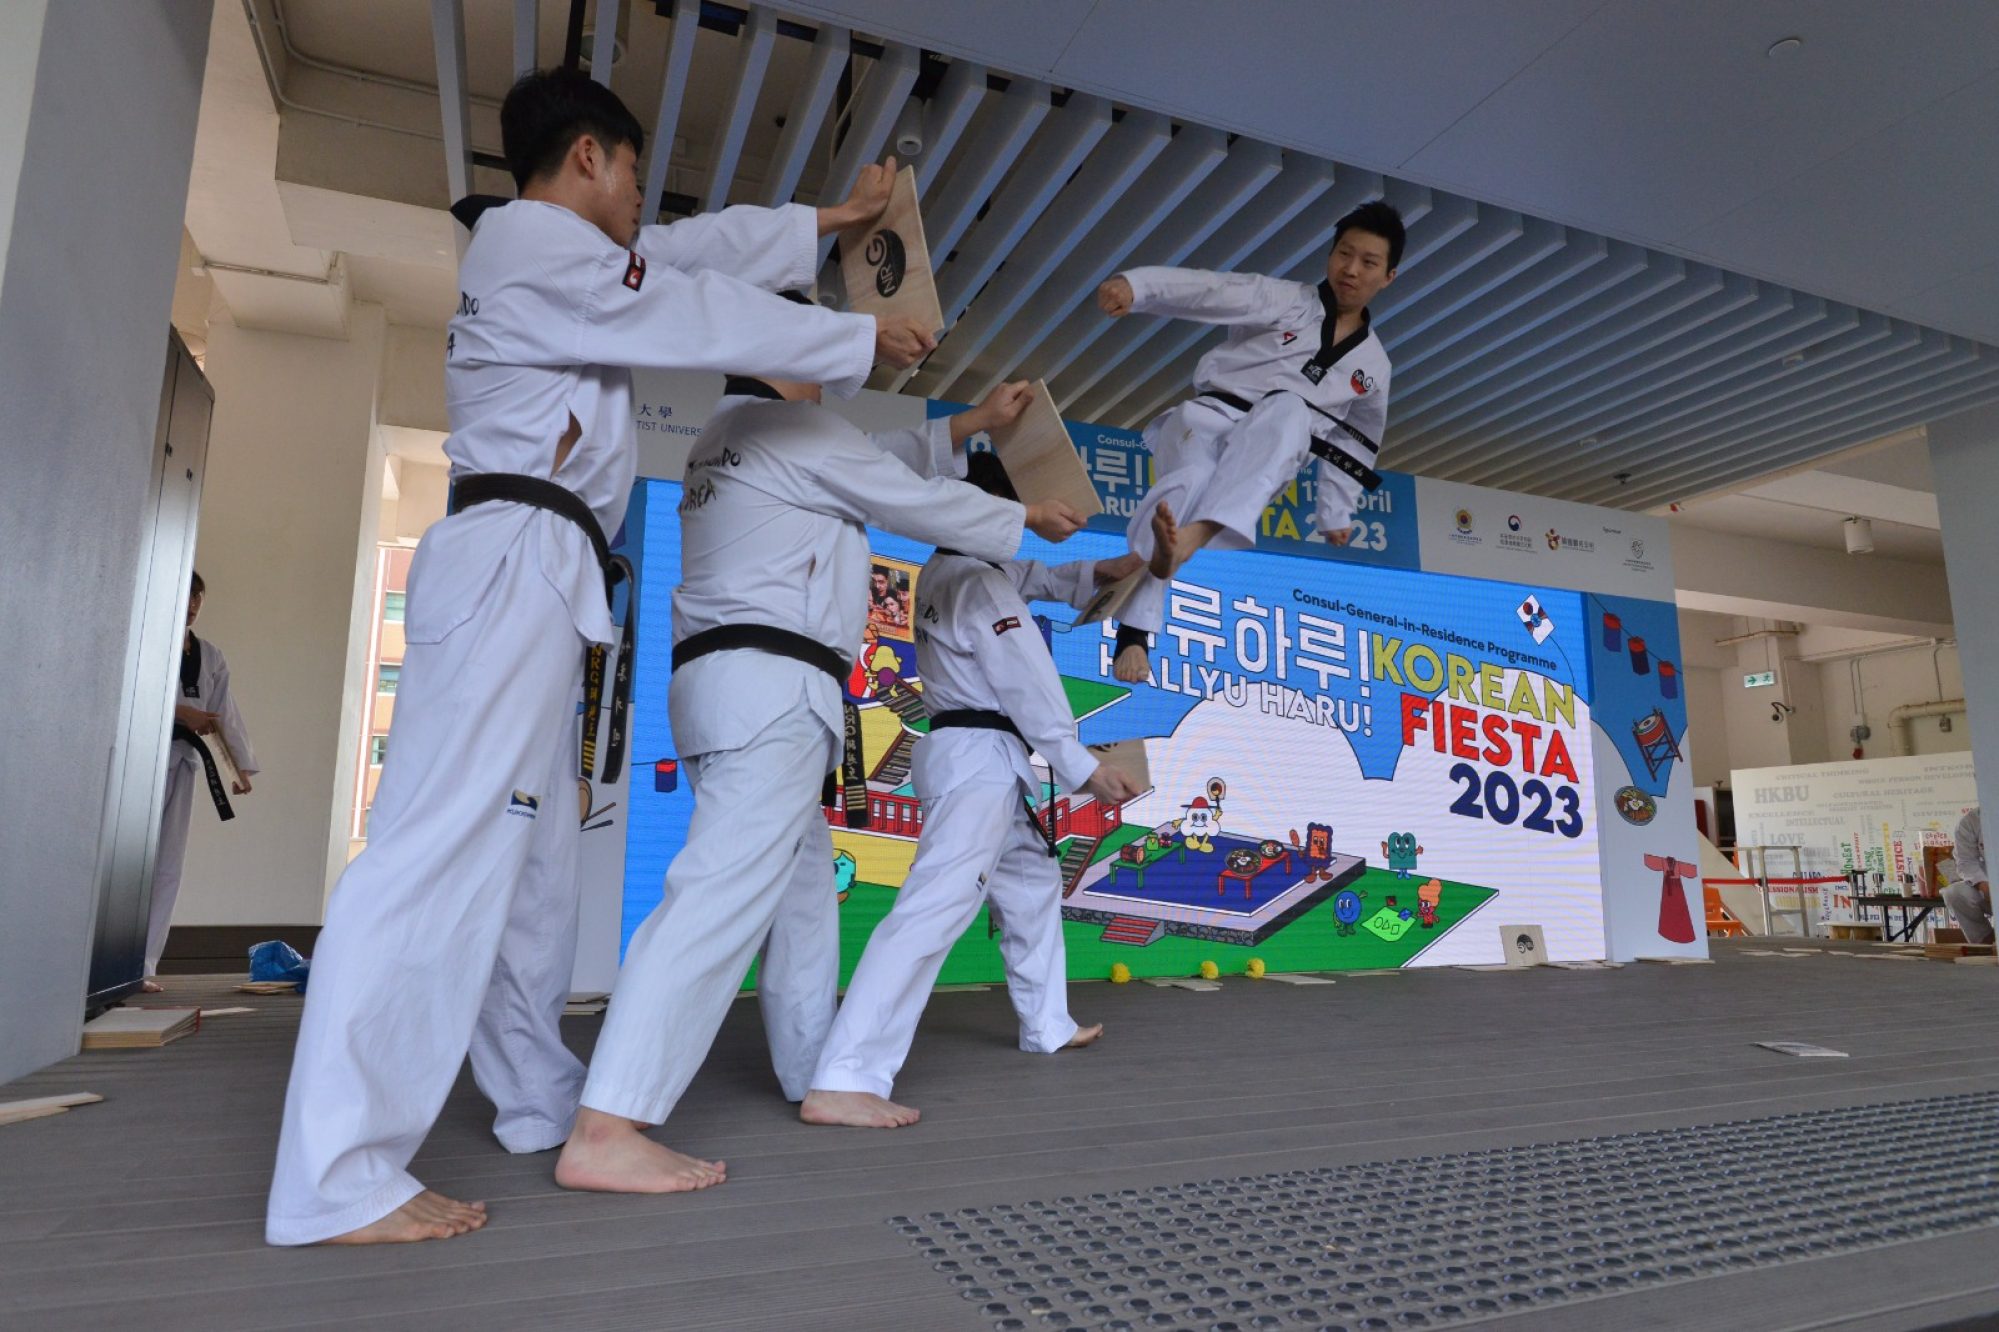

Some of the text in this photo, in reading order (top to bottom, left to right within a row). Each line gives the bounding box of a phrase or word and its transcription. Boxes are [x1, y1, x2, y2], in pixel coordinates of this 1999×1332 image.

[637, 403, 673, 418] 大學
[1097, 434, 1150, 451] Consul-G
[1353, 490, 1393, 515] pril
[1304, 513, 1388, 552] 223
[1102, 579, 1371, 698] 류하루!
[1292, 588, 1558, 671] Consul-General-in-Residence Programme
[1100, 642, 1373, 737] HLLYU HARU!
[1371, 632, 1577, 730] KOREAN
[1400, 691, 1580, 784] FIESTA
[1448, 762, 1584, 839] 2023
[1754, 784, 1810, 805] HKBU
[1884, 786, 1935, 797] HERITAGE
[1785, 815, 1846, 827] INTELLECTUAL
[1769, 832, 1805, 846] LOVE
